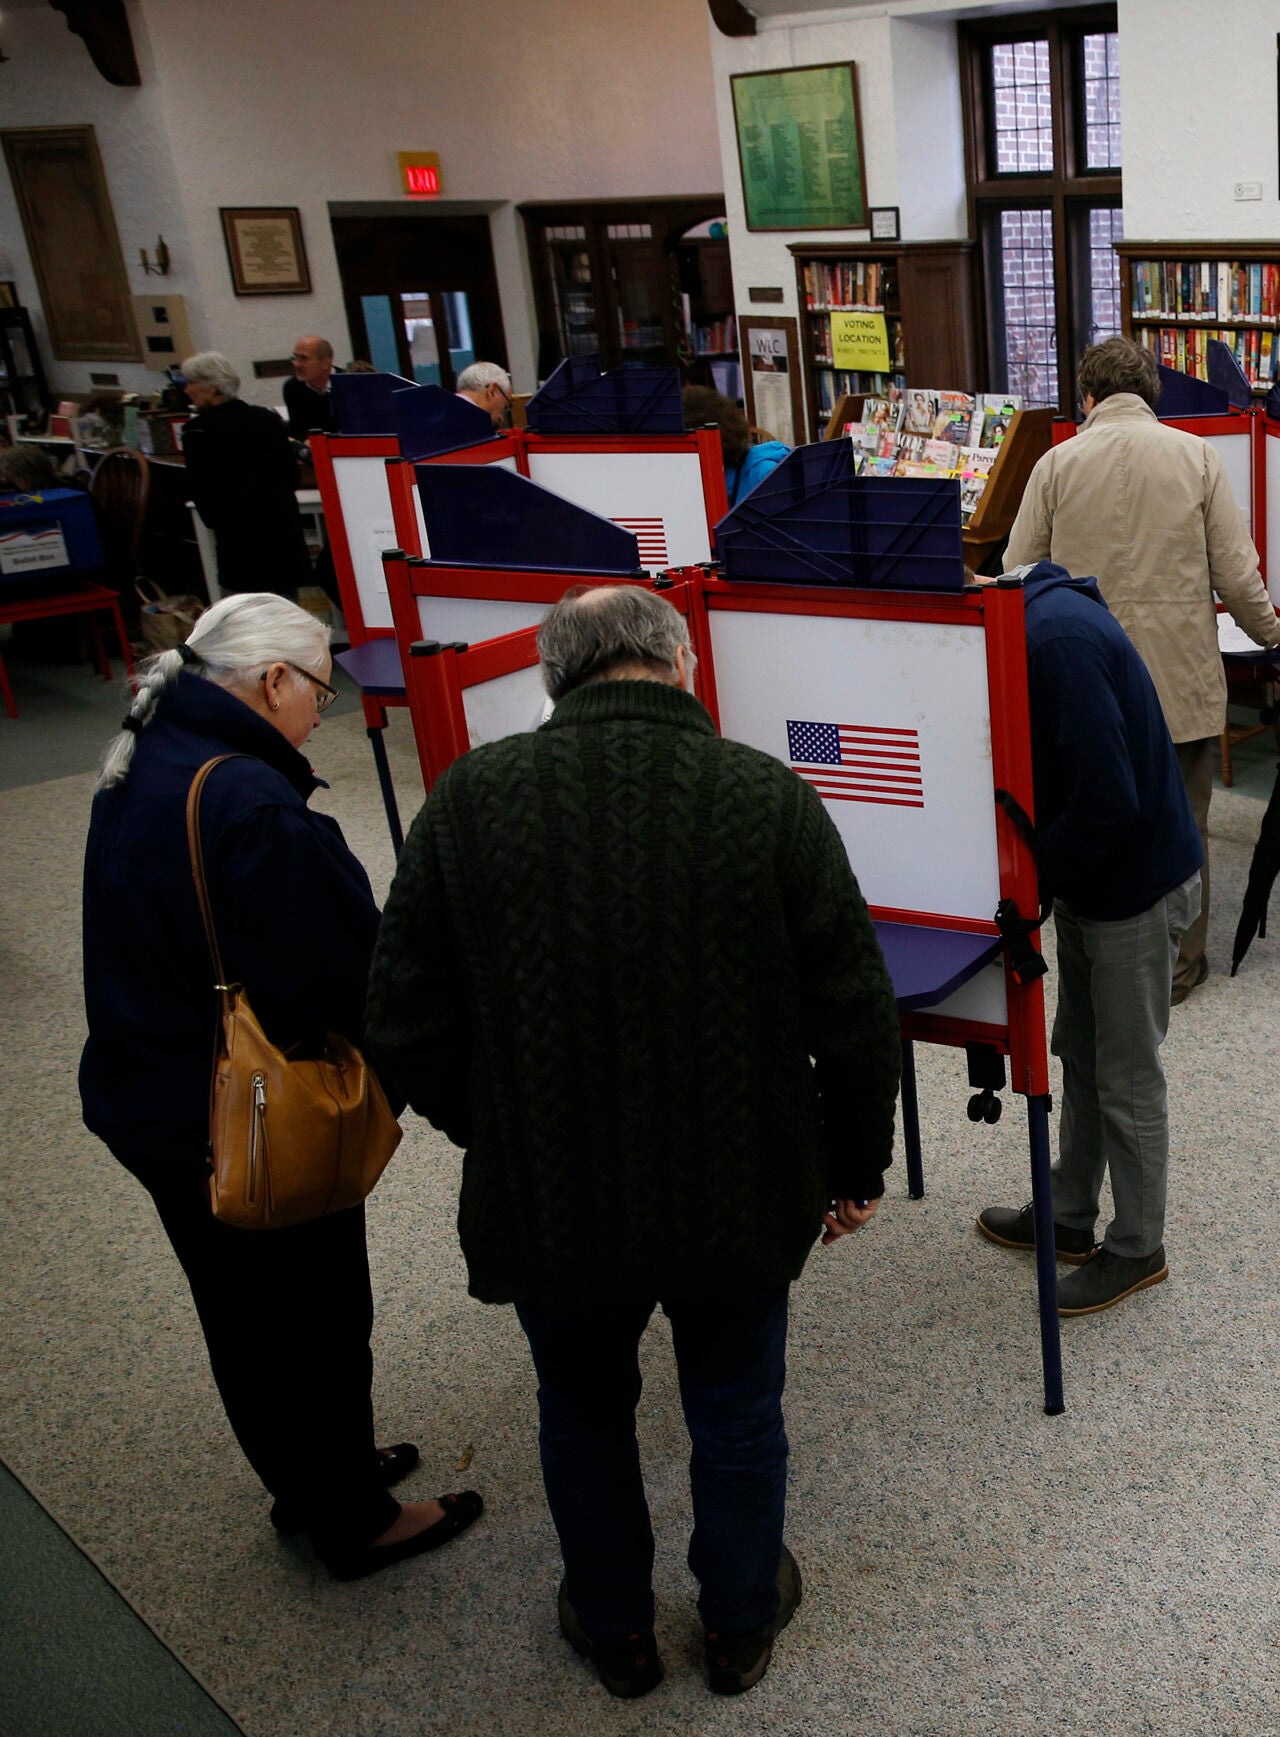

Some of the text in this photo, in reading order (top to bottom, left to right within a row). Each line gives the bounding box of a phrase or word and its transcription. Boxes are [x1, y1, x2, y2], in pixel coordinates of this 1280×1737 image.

[407, 166, 439, 192] EXIT
[844, 319, 876, 330] VOTING
[755, 338, 780, 354] WLC
[838, 334, 882, 345] LOCATION
